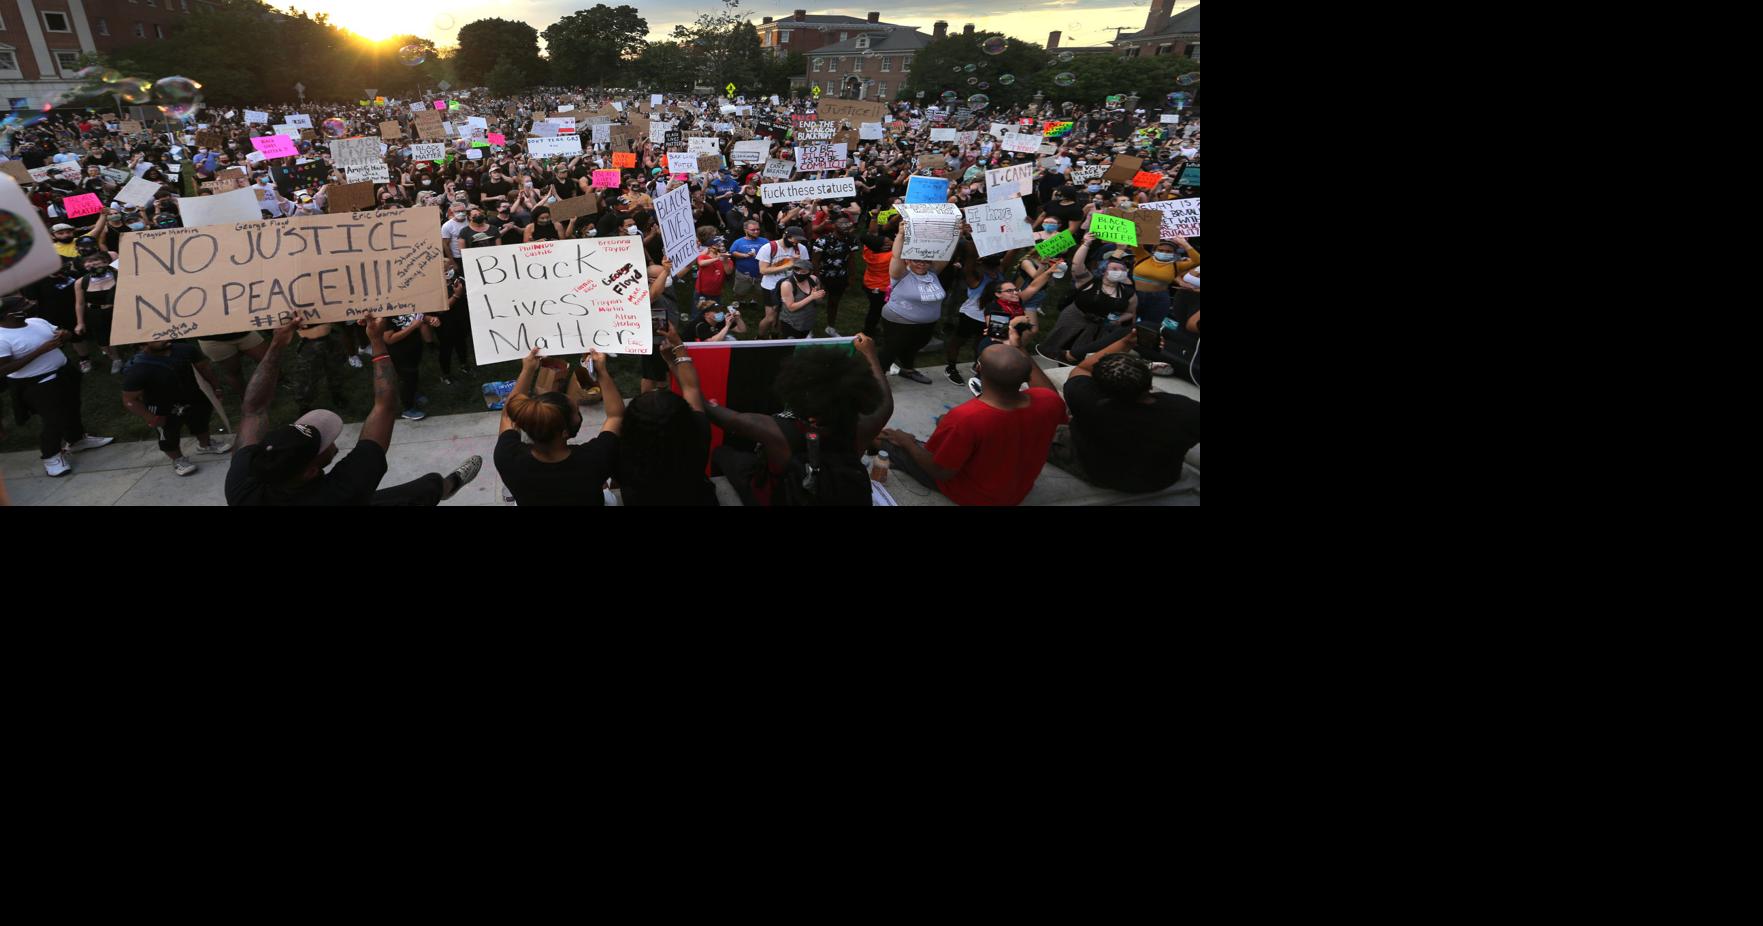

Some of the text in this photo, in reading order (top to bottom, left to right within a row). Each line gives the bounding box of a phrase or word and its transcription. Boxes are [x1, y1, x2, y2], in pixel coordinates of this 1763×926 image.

[797, 132, 818, 140] BLACK
[338, 137, 380, 150] BLACK
[800, 144, 837, 154] TO BE
[338, 147, 380, 158] LIVES
[802, 151, 835, 159] SILENT
[800, 159, 847, 170] COMPLICIT
[801, 157, 813, 165] IS
[991, 171, 1000, 187] I
[763, 183, 854, 199] fuck these statues
[656, 187, 687, 219] BLACK
[1180, 200, 1192, 208] IS
[352, 209, 406, 221] Eric Garner
[967, 207, 981, 223] I
[1098, 216, 1127, 227] BLACK
[235, 222, 266, 232] George
[661, 207, 691, 248] LIVES
[1097, 225, 1128, 233] LIVES
[1039, 235, 1065, 250] BLACK
[1095, 231, 1133, 242] MATTER
[132, 219, 411, 276] NO JUSTICE
[602, 245, 631, 253] Taylor
[670, 239, 697, 268] MATTER
[475, 244, 603, 286] Black
[613, 269, 643, 295] Floyd
[135, 259, 392, 330] NO PEACE!!!!
[483, 293, 590, 320] Lives
[489, 320, 635, 355] Matter
